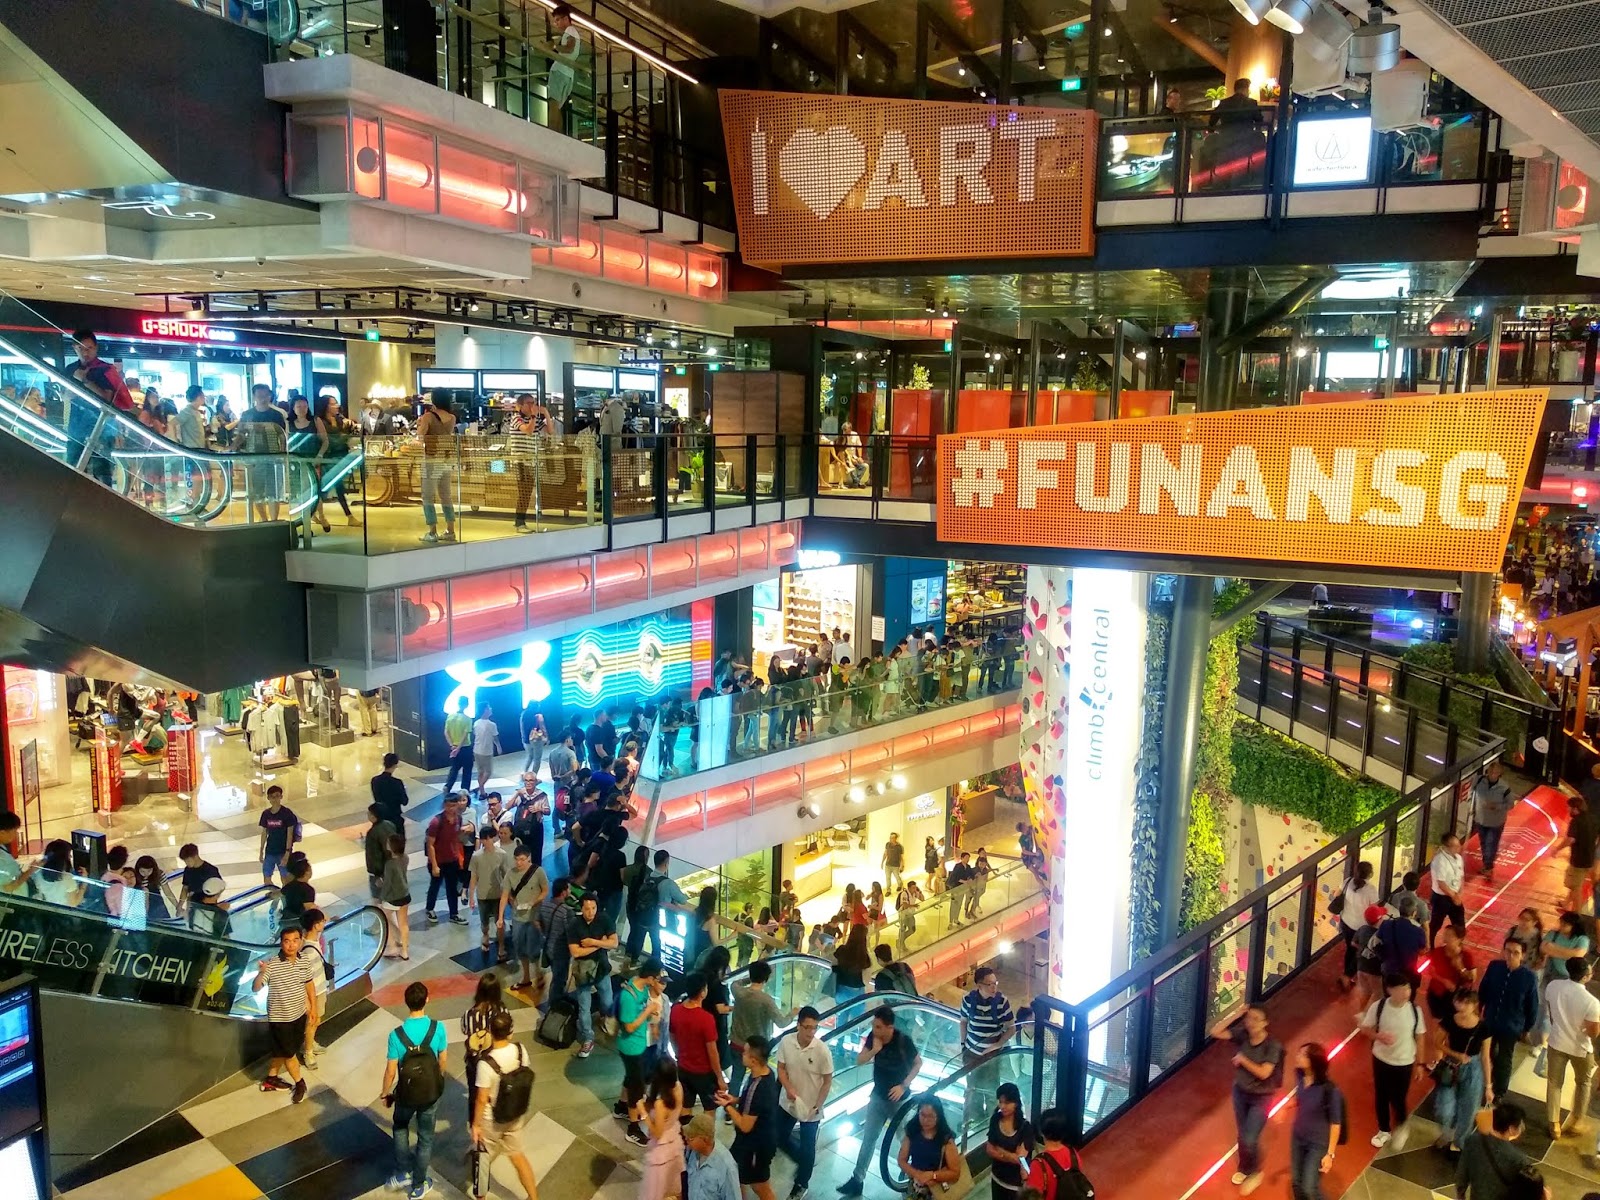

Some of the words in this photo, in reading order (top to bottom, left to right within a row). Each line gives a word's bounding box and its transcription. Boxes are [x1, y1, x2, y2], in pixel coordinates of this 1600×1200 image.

[863, 119, 1056, 211] ART
[142, 320, 209, 339] G-SHOCK
[951, 437, 1509, 531] #FUNANSG
[1091, 609, 1110, 694] central
[1086, 714, 1104, 780] climb
[0, 928, 93, 969] IRELESS
